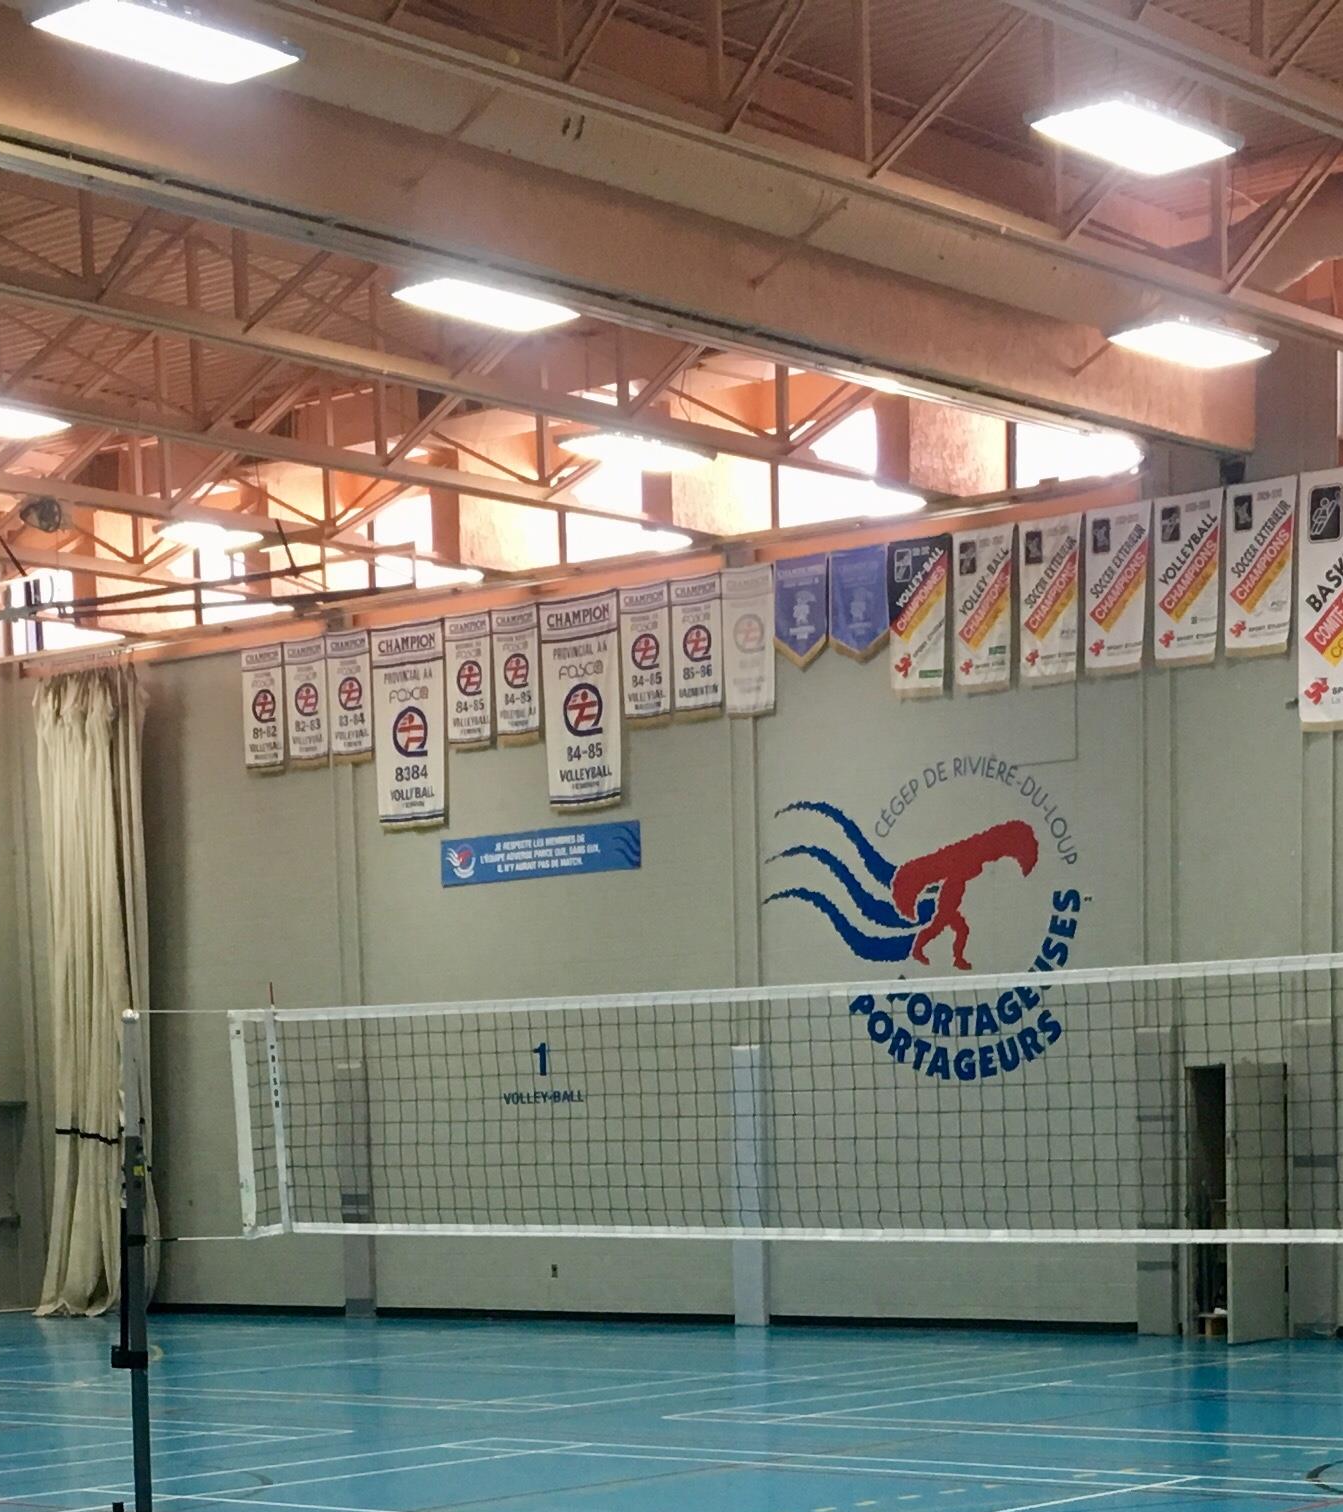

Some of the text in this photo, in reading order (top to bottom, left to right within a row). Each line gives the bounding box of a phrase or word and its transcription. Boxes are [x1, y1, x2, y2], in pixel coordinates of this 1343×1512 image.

[1158, 512, 1219, 586] VOLLEYBALL
[1230, 543, 1259, 580] SOCCER
[1235, 528, 1291, 600] CHAMPIONS
[674, 581, 717, 599] CHAMPION
[895, 546, 945, 608] VOLLEY-BALL
[958, 548, 1010, 617] VOLLEY-BALL
[1089, 565, 1116, 600] SOCCER
[1094, 551, 1147, 621] CHAMPIONS
[1163, 538, 1218, 610] CHAMPIONS
[623, 589, 665, 607] CHAMPION
[896, 564, 946, 632] CHAMPIONNES
[962, 571, 1010, 640] CHAMPIONS
[1028, 560, 1078, 630] CHAMPIONS
[448, 620, 487, 635] CHAMPION
[546, 603, 610, 629] CHAMPION
[330, 638, 366, 651] CHAMPION
[377, 632, 437, 655] CHAMPION
[455, 698, 485, 714] 84-85
[566, 743, 604, 762] 84-85
[559, 765, 613, 783] VOLLEYBALL
[874, 754, 1080, 866] CÉGEP DE RIVIÈRE-DU-LOUP
[884, 888, 1082, 1038] ORTAGESES
[848, 993, 1064, 1081] PORTAGEURS
[533, 1042, 547, 1077] 1
[503, 1089, 585, 1105] VOLLEY-BALL
